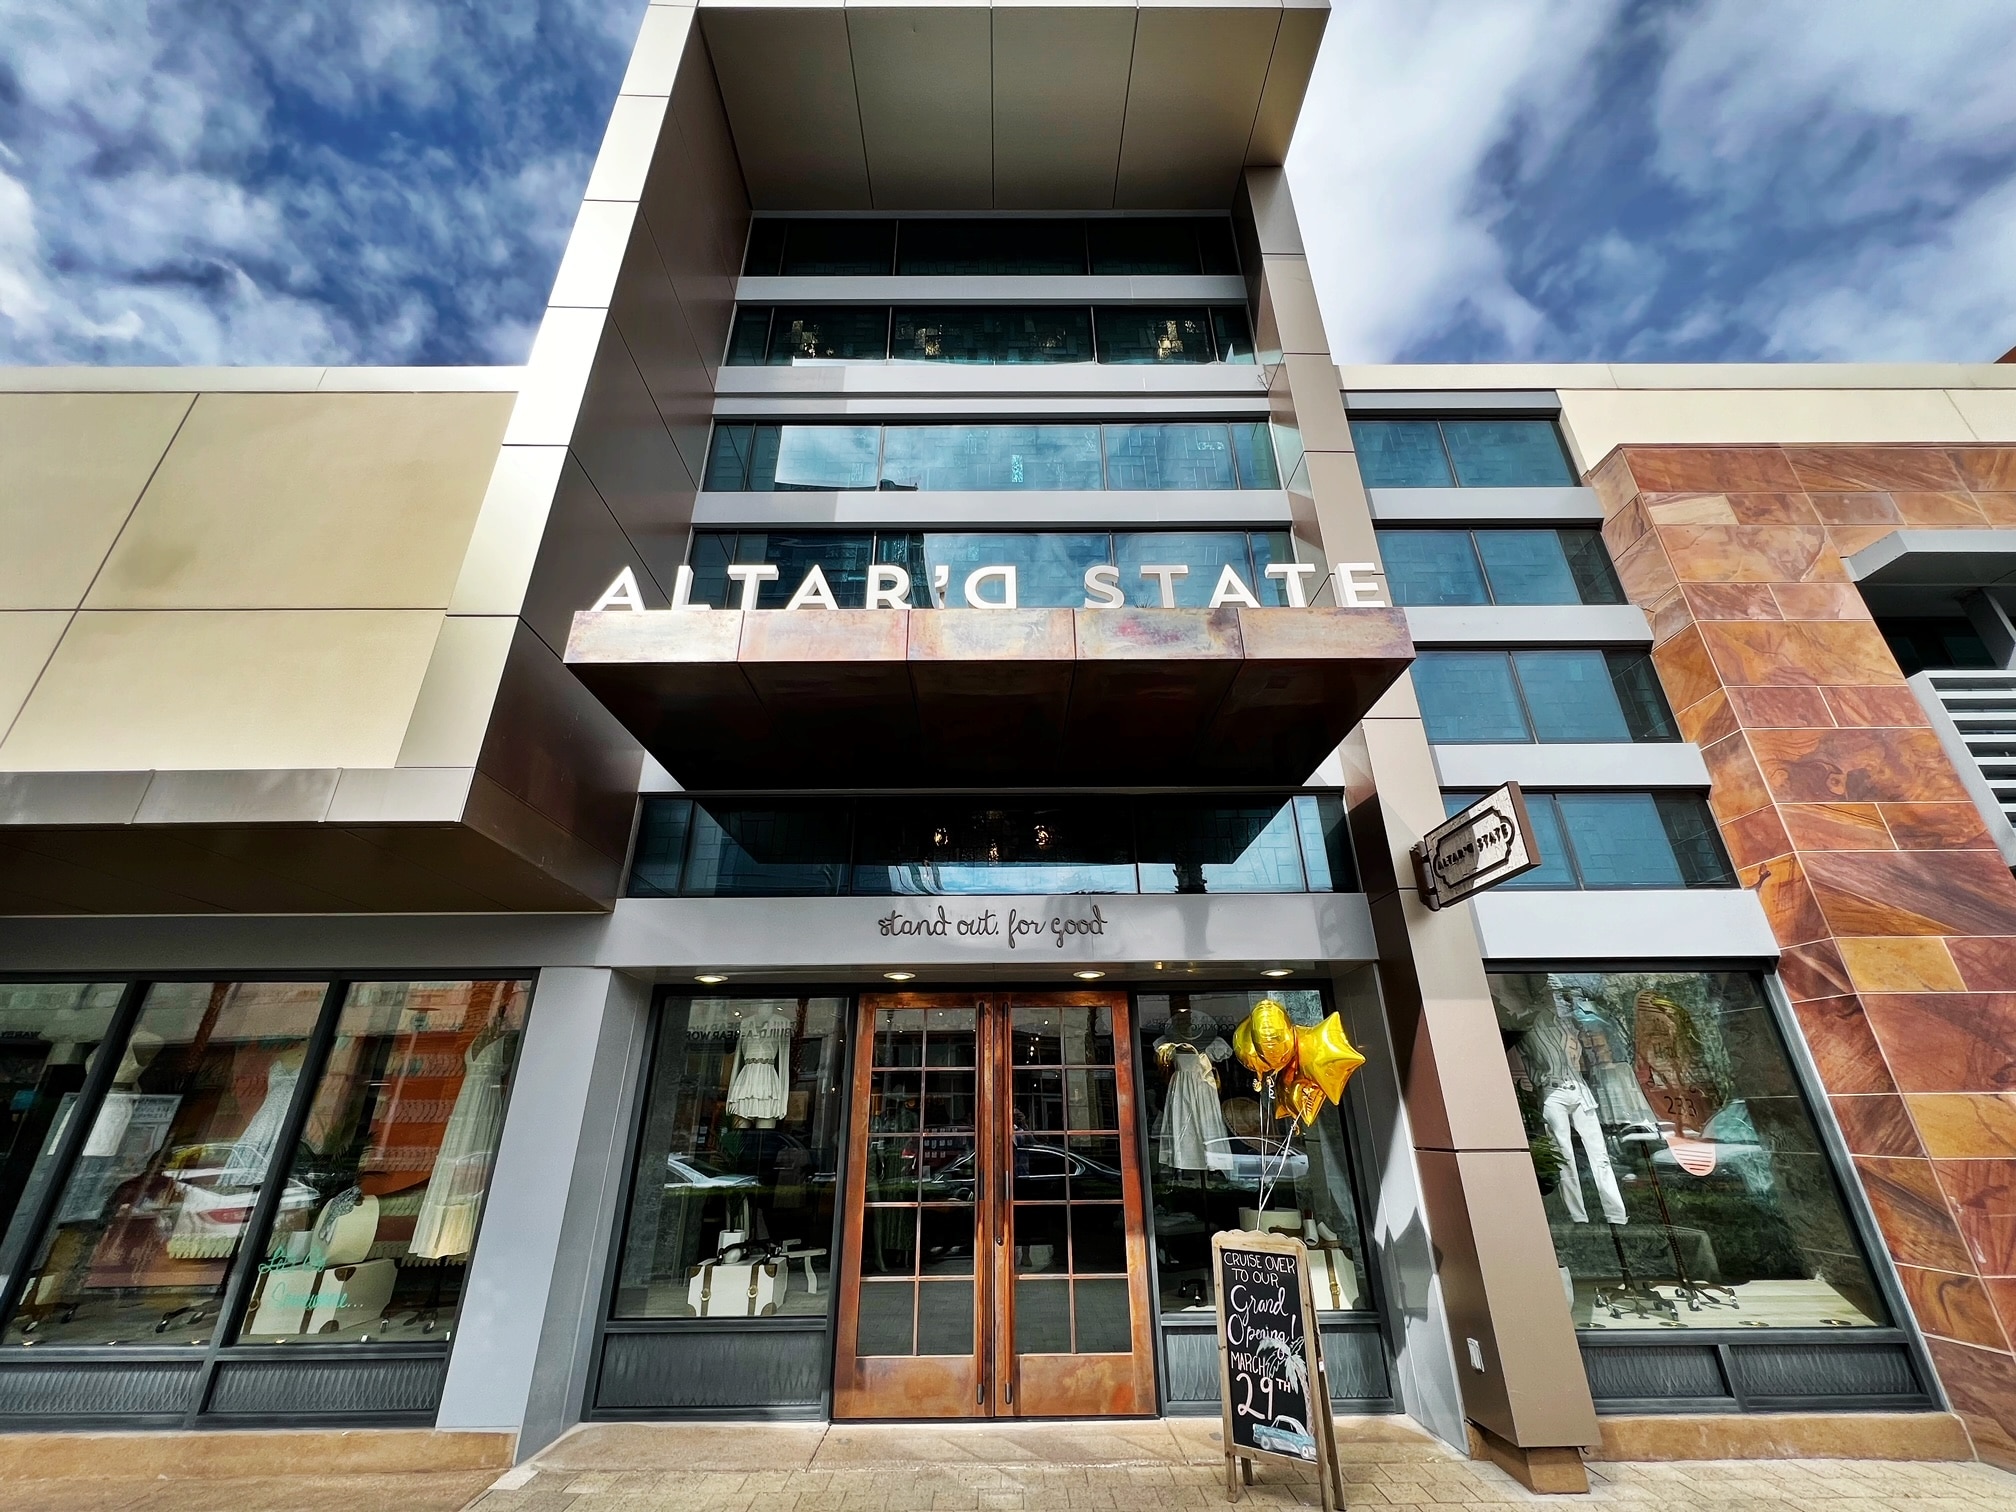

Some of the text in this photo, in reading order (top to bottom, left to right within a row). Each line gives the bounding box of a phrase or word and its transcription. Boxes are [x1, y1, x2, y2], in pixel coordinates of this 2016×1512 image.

[590, 562, 1389, 610] ALTAR'D STATE
[1476, 823, 1509, 852] STATE
[878, 904, 1108, 949] stand out. for good
[1224, 1252, 1296, 1274] CRUISE OVER
[1232, 1268, 1279, 1288] TO OUR
[1230, 1284, 1289, 1326] Grand
[1230, 1350, 1267, 1378] MARCH
